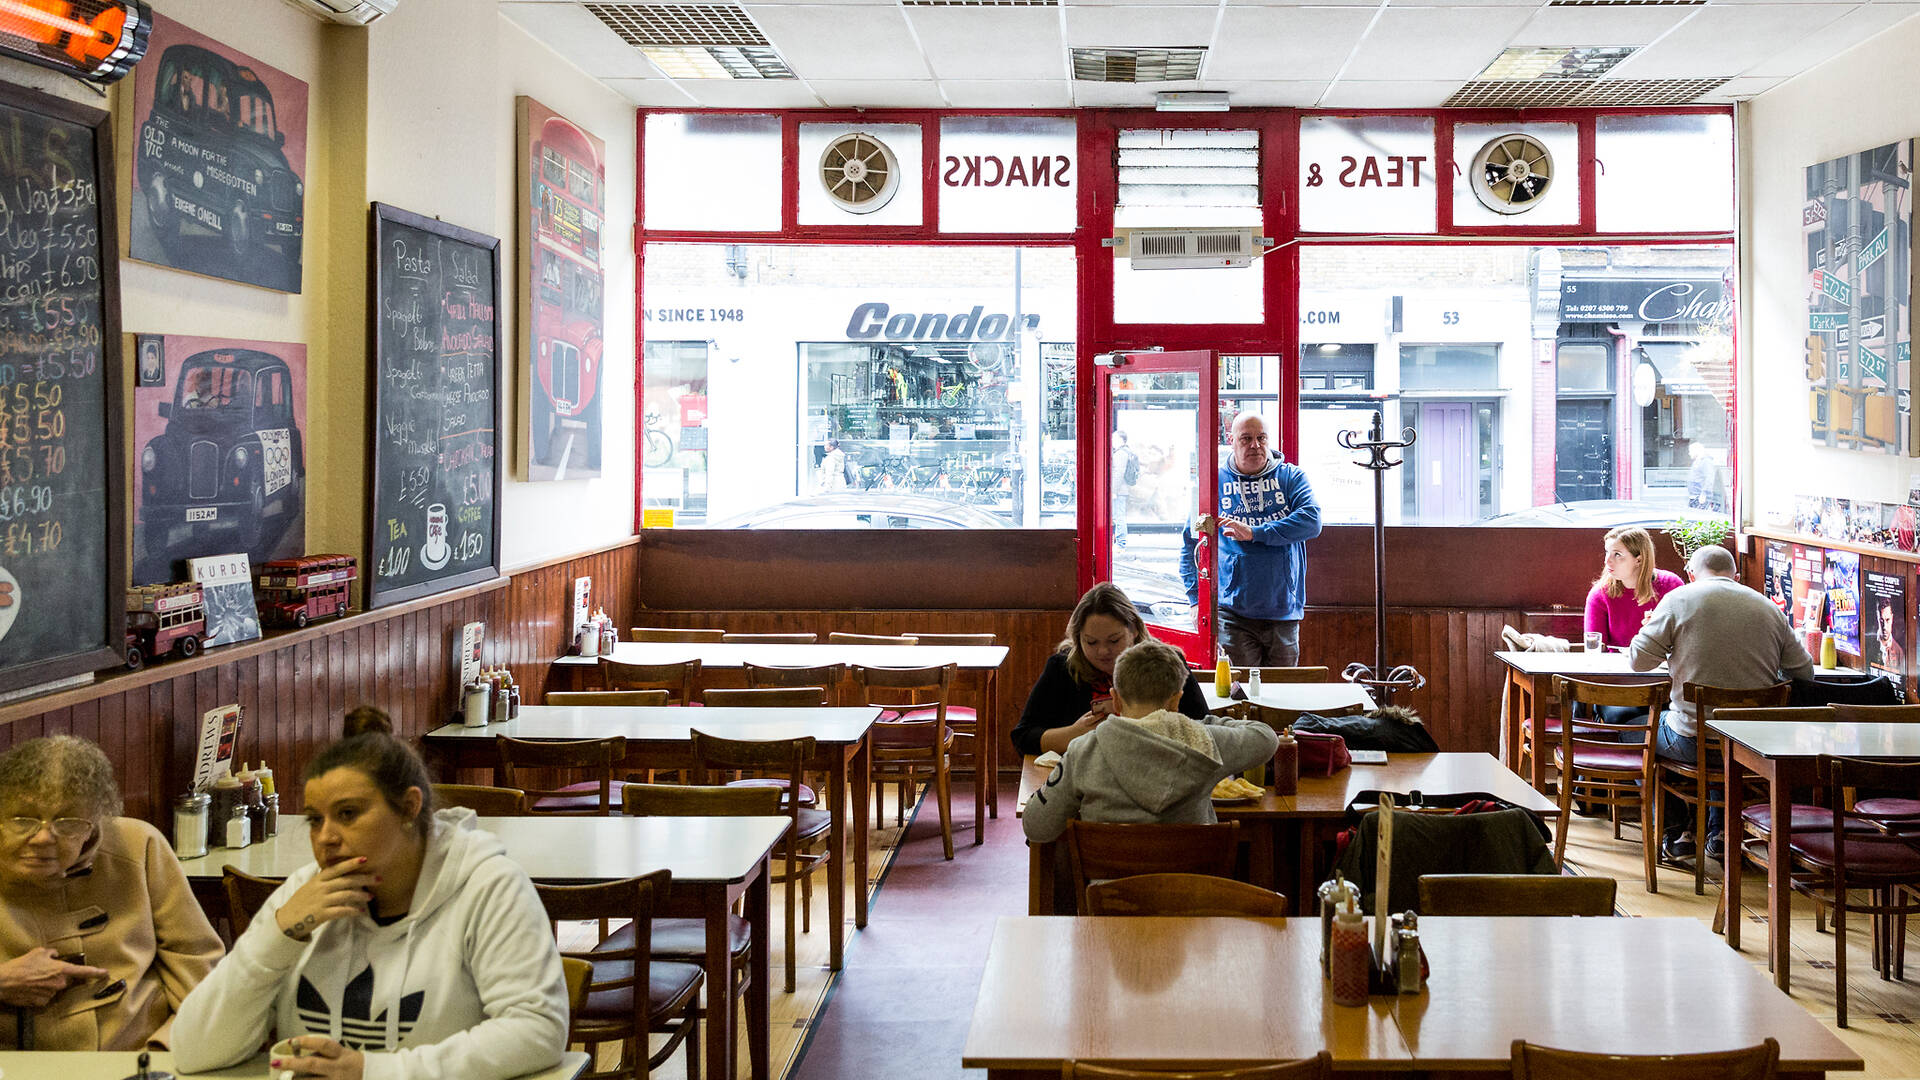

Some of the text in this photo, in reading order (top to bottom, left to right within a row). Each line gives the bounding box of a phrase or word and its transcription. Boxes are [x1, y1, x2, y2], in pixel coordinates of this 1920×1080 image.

[155, 116, 169, 129] THE
[144, 126, 165, 146] OLD
[145, 140, 162, 159] VIC
[171, 137, 227, 166] A MOON FOR THE
[207, 165, 257, 196] MISBEGOTTEN
[175, 197, 196, 217] EUGENE
[393, 240, 431, 274] Pasta
[1858, 248, 1874, 271] PARK
[1875, 234, 1886, 256] AV
[452, 251, 479, 284] Salad
[1566, 285, 1577, 293] 55
[659, 309, 705, 322] SINCE
[710, 309, 744, 322] 1948
[846, 302, 1041, 341] Condor
[1443, 311, 1460, 325] 53
[266, 468, 289, 483] LONDON
[270, 480, 285, 492] 2012
[1223, 477, 1280, 496] OREGON
[1275, 491, 1285, 505] 8
[388, 518, 408, 542] TEA
[197, 562, 247, 578] KURDS
